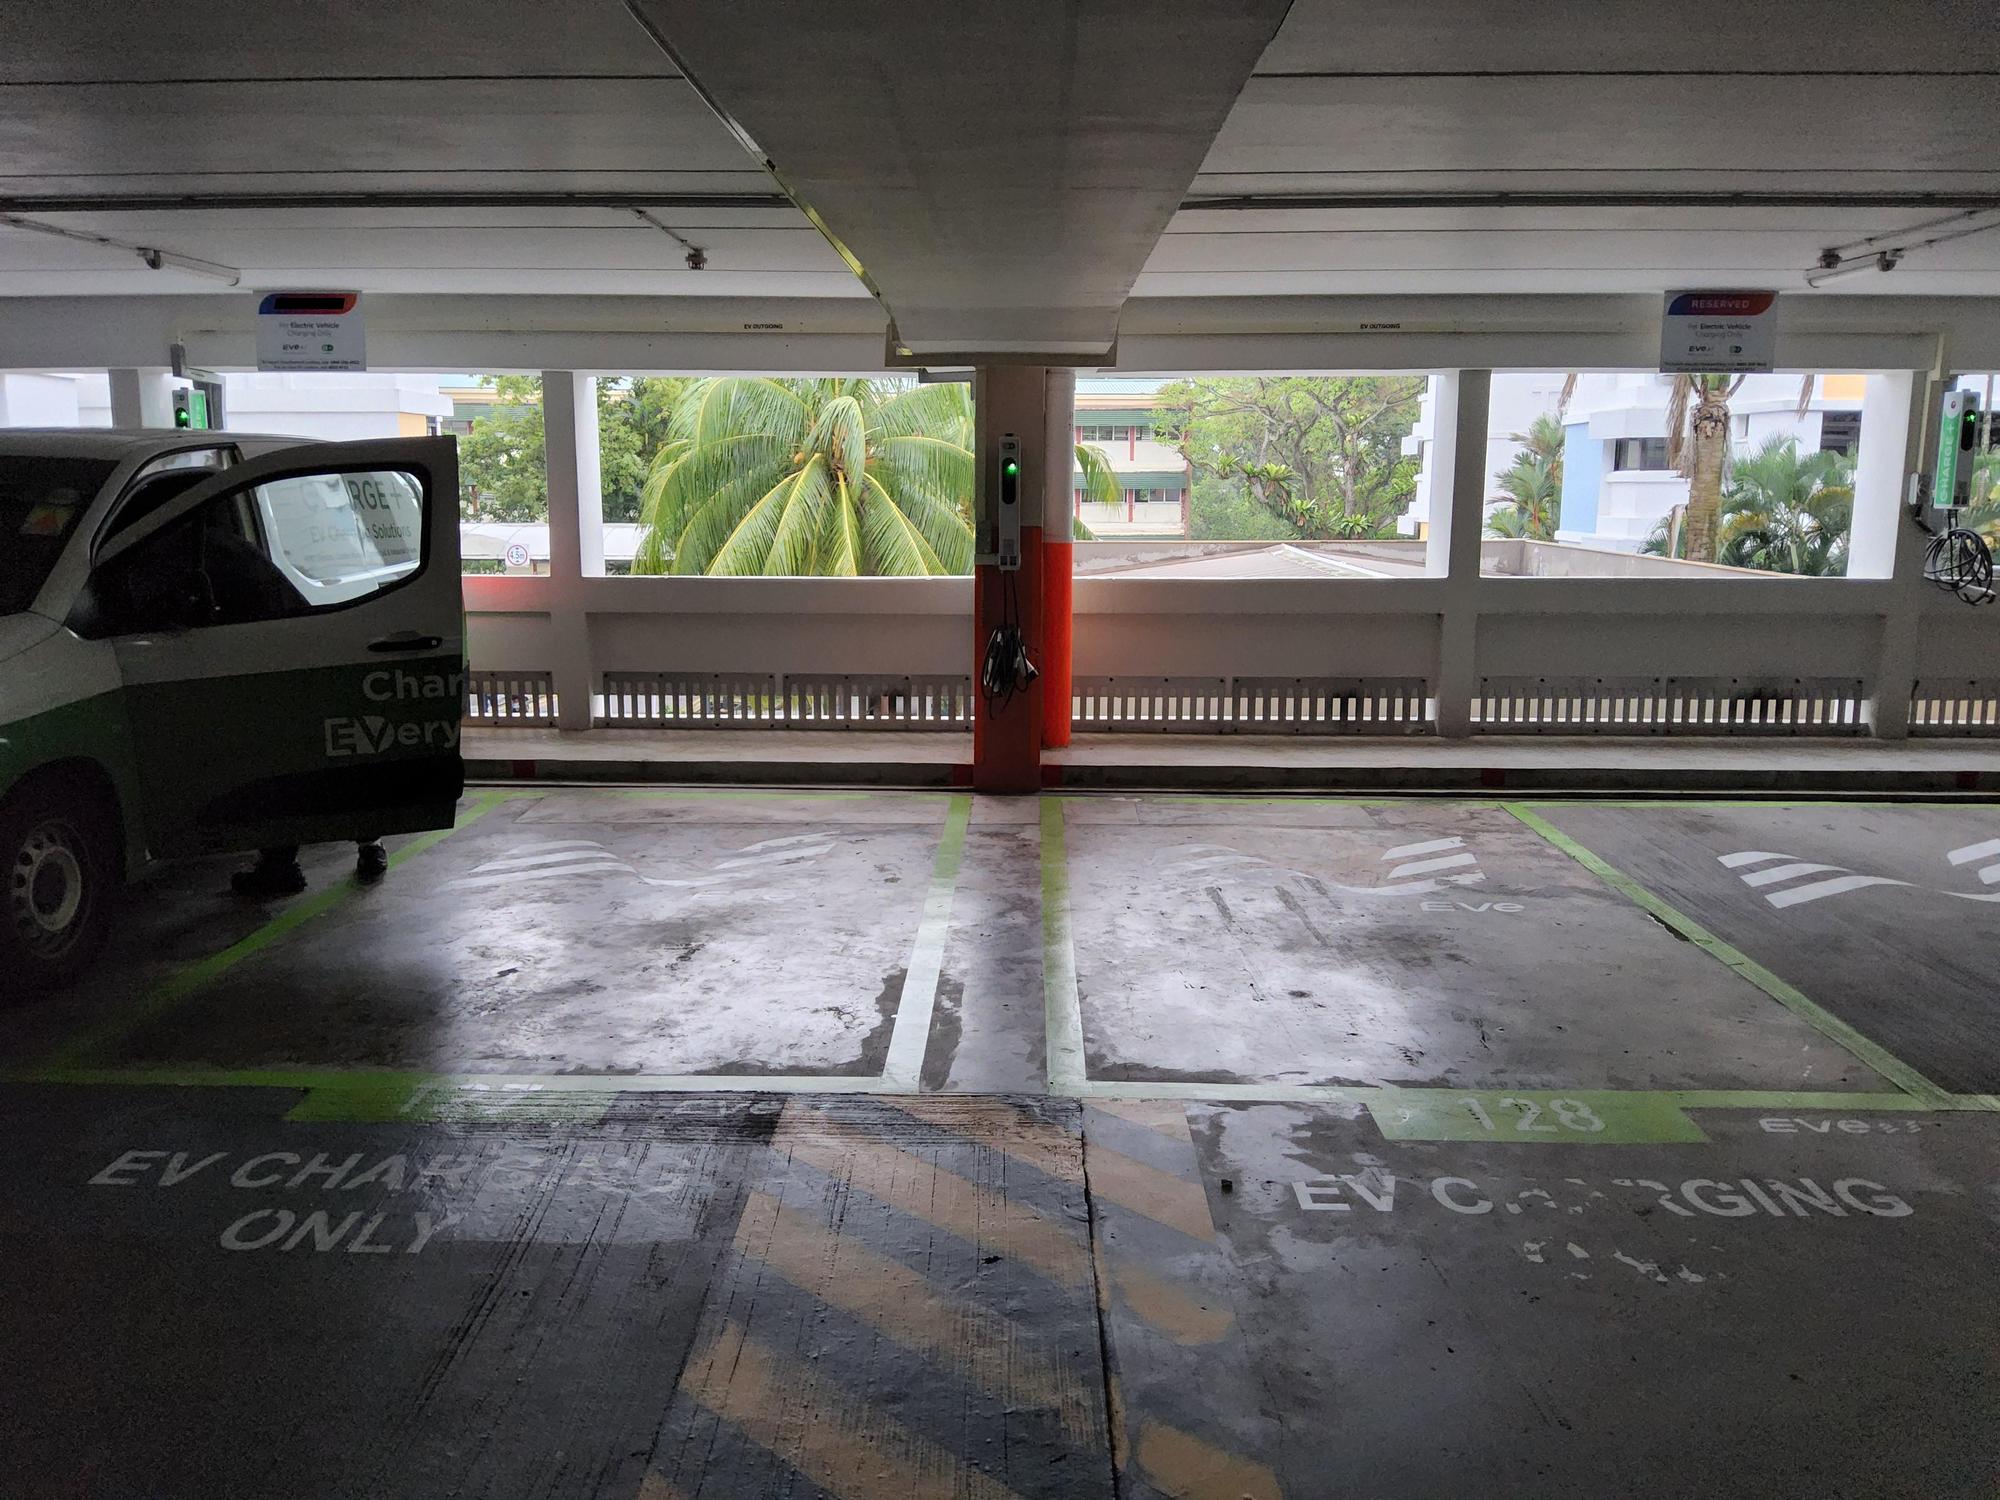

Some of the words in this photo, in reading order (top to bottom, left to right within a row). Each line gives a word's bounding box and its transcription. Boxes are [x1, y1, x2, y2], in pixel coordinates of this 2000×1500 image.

[1691, 299, 1750, 309] RESERVED
[1458, 1096, 1606, 1133] 128
[87, 1150, 231, 1188] EV
[1290, 1173, 1397, 1213] EV
[219, 1207, 467, 1254] ONLY
